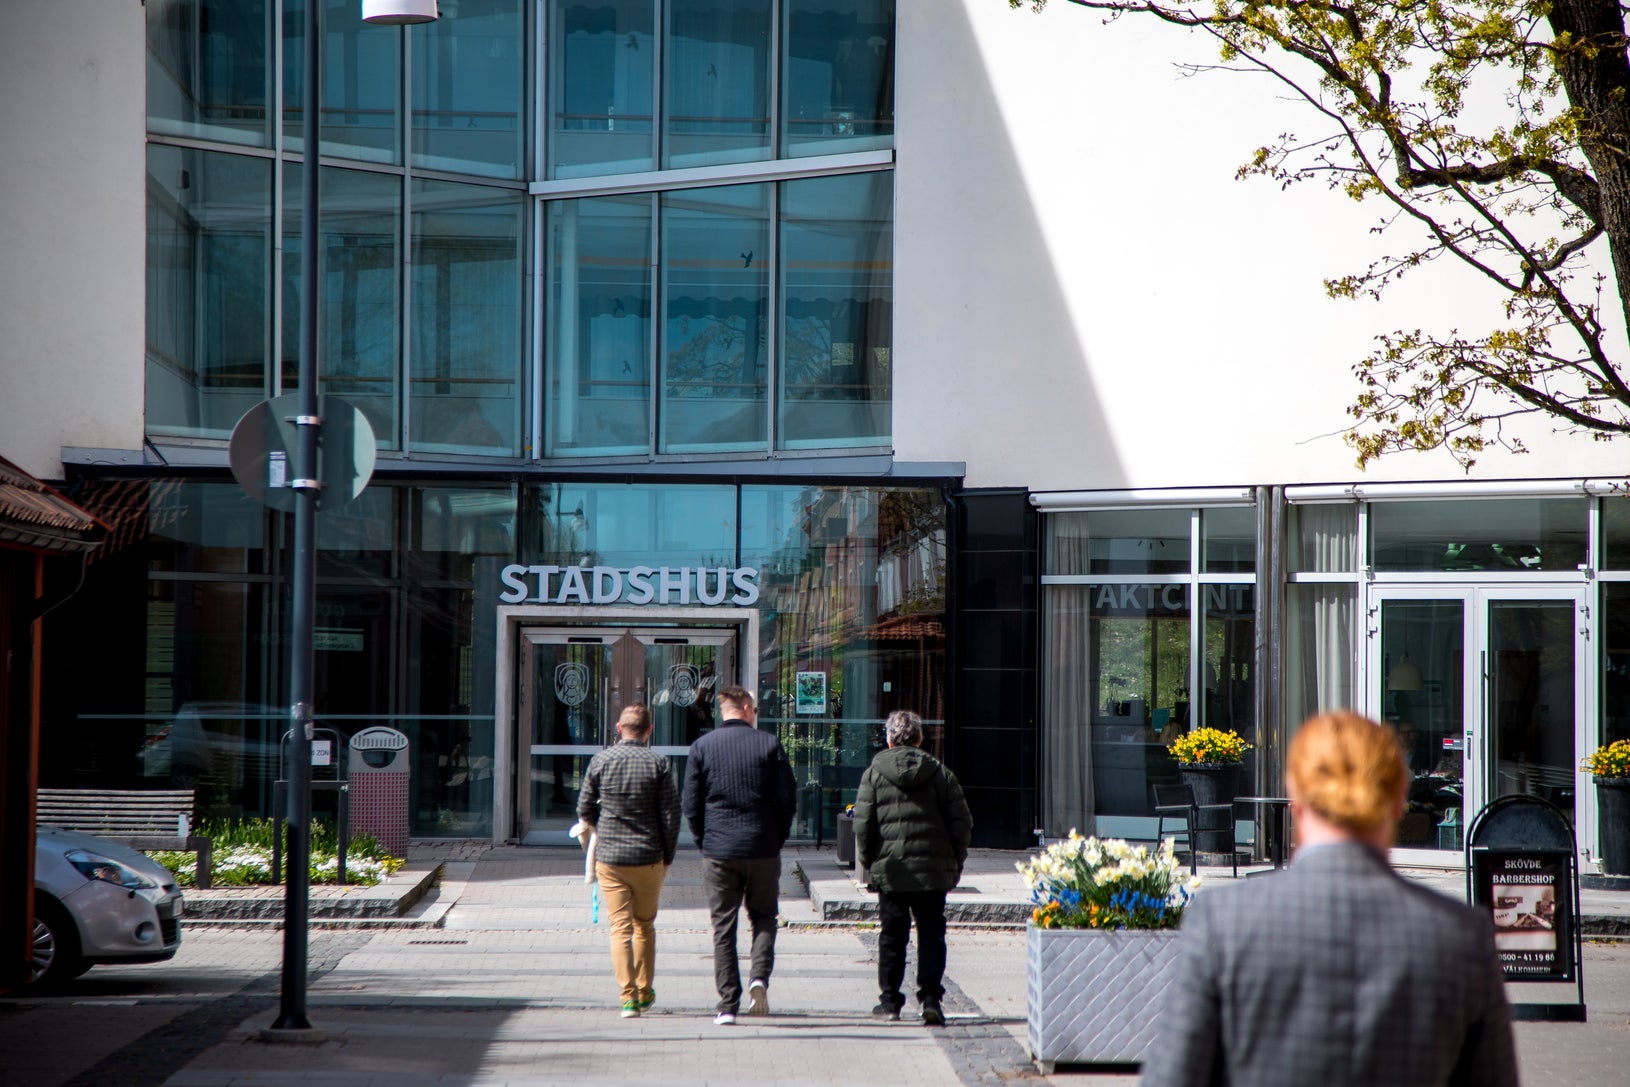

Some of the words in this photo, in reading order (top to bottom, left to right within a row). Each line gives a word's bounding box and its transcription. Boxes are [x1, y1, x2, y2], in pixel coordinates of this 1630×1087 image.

[499, 563, 760, 607] STADSHUS
[1504, 858, 1542, 869] SKÖVDE
[1492, 874, 1555, 884] BARBERSHOP
[1523, 952, 1532, 962] 41
[1535, 952, 1544, 962] 19
